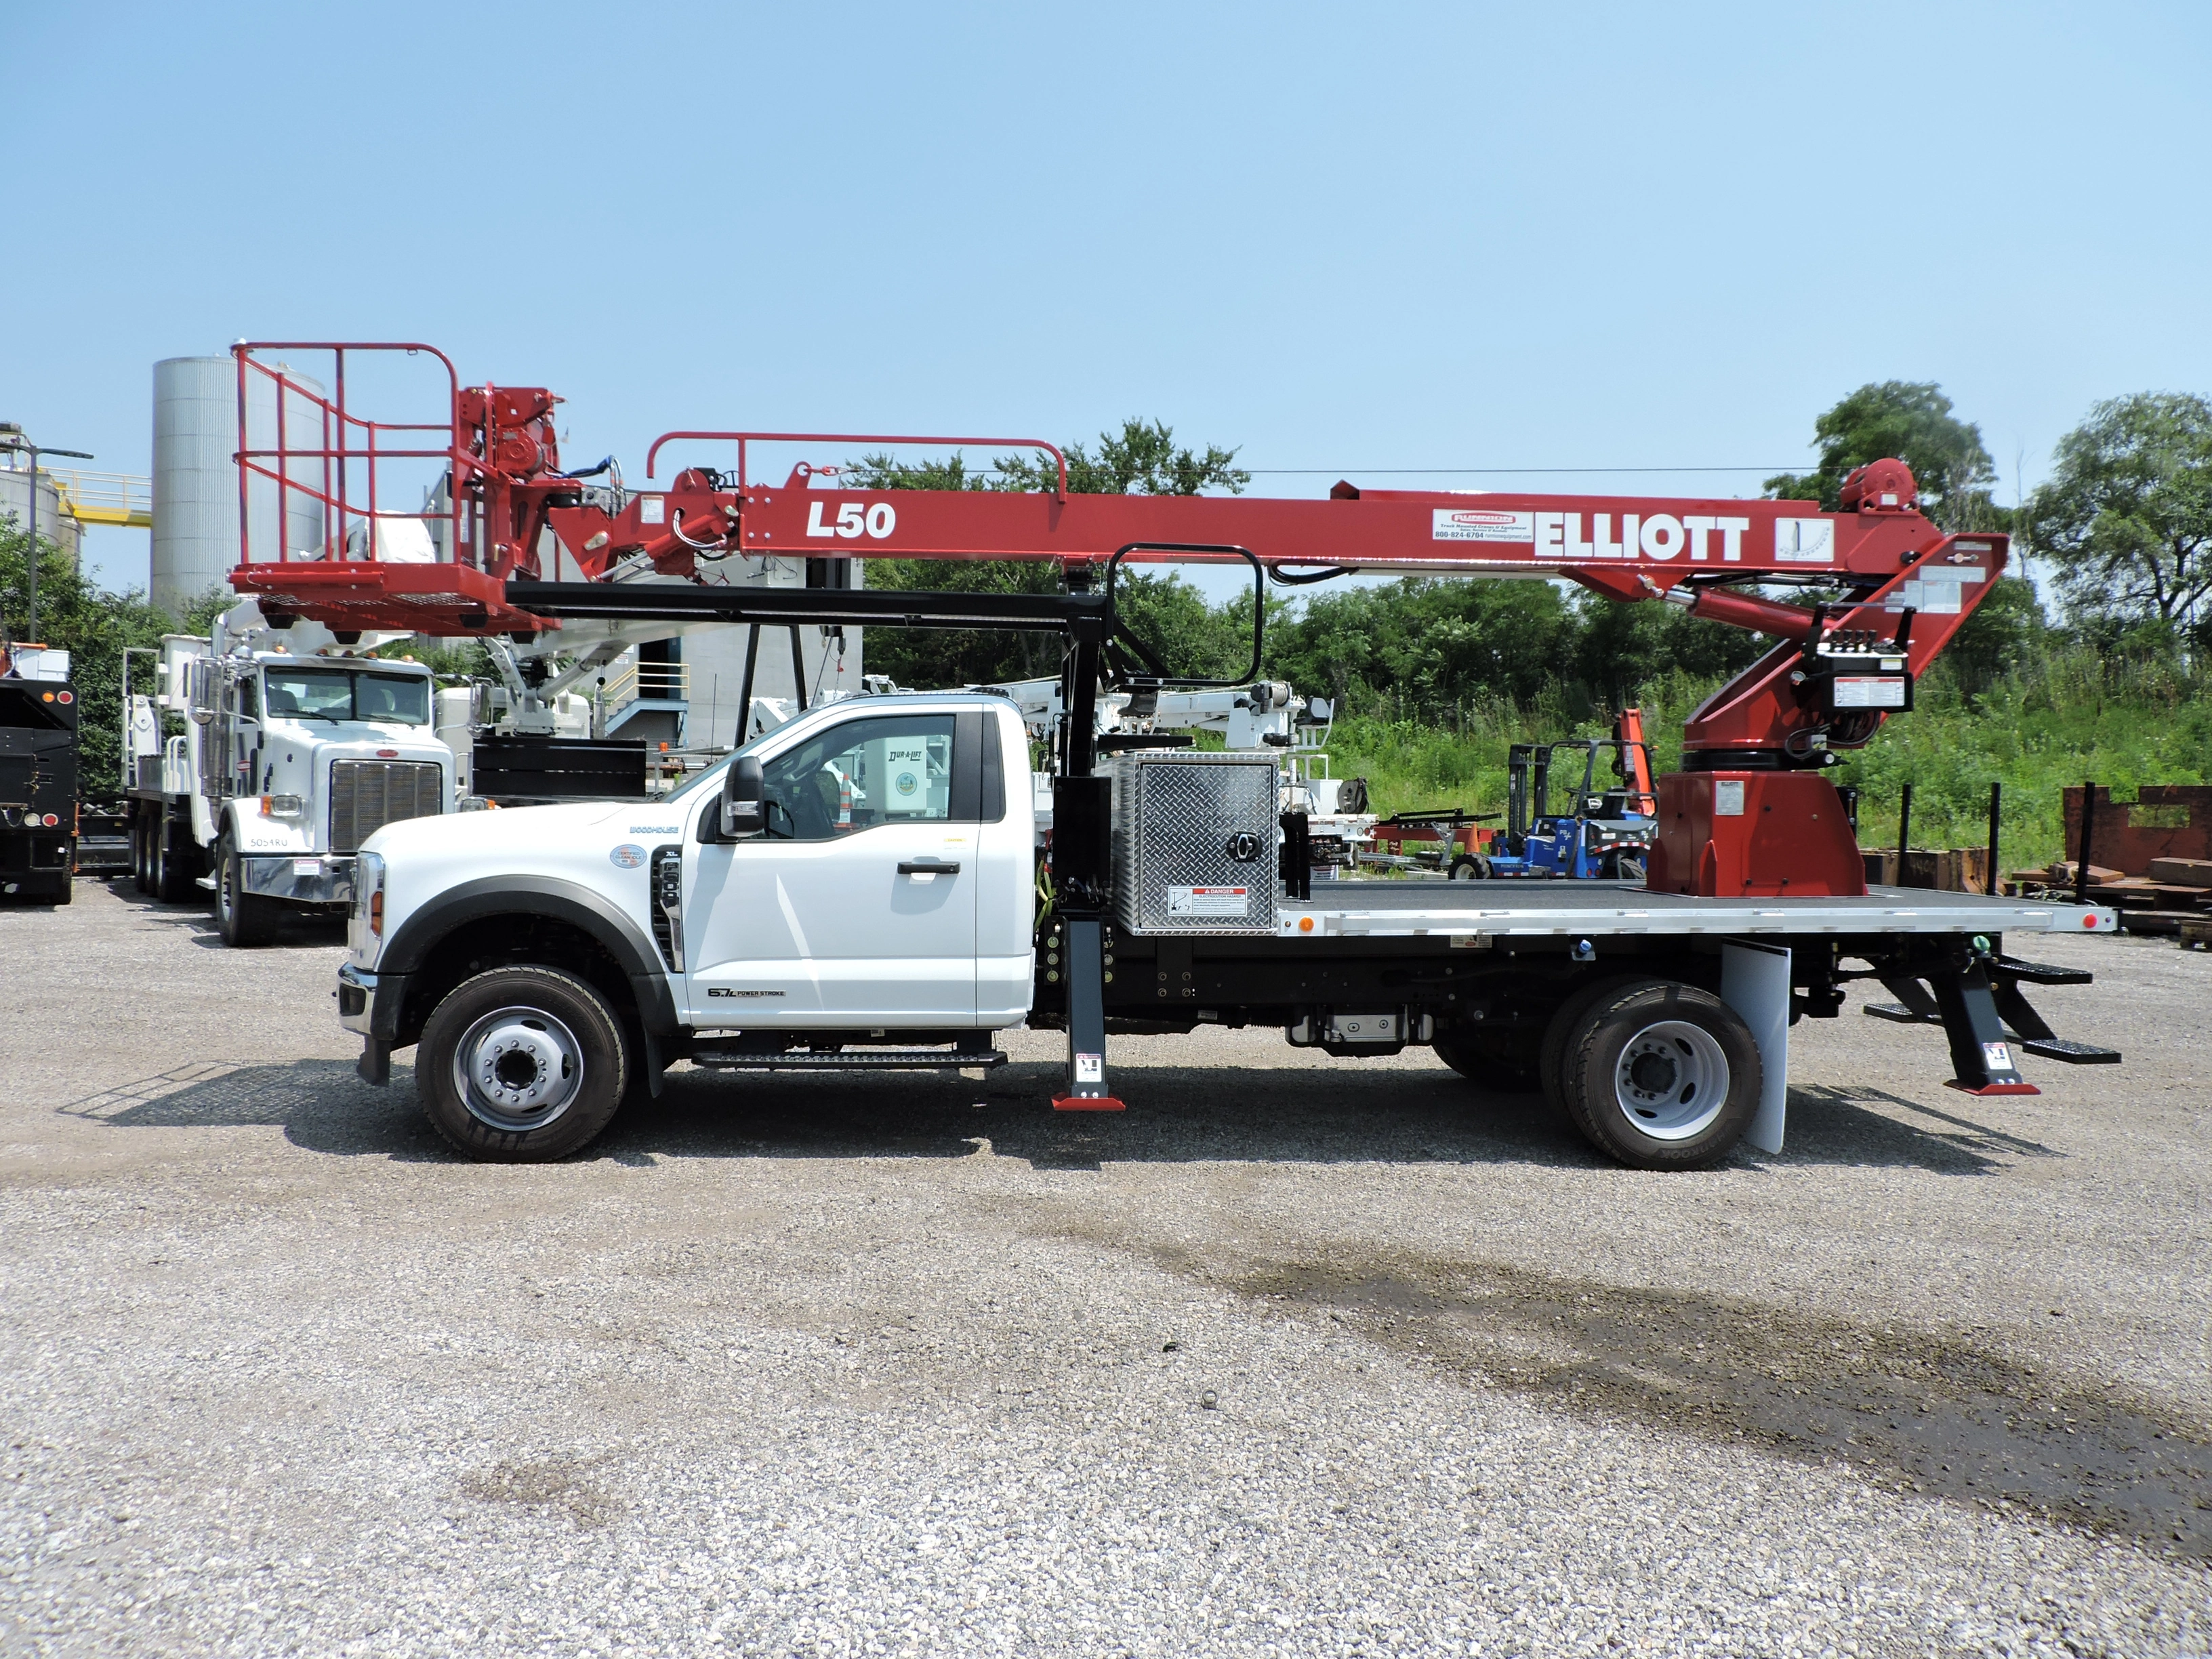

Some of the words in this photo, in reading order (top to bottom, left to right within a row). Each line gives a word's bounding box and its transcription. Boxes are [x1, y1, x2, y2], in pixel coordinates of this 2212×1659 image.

[806, 501, 896, 539] L50
[1534, 512, 1749, 561] ELLIOTT
[708, 988, 737, 997] 6.7L
